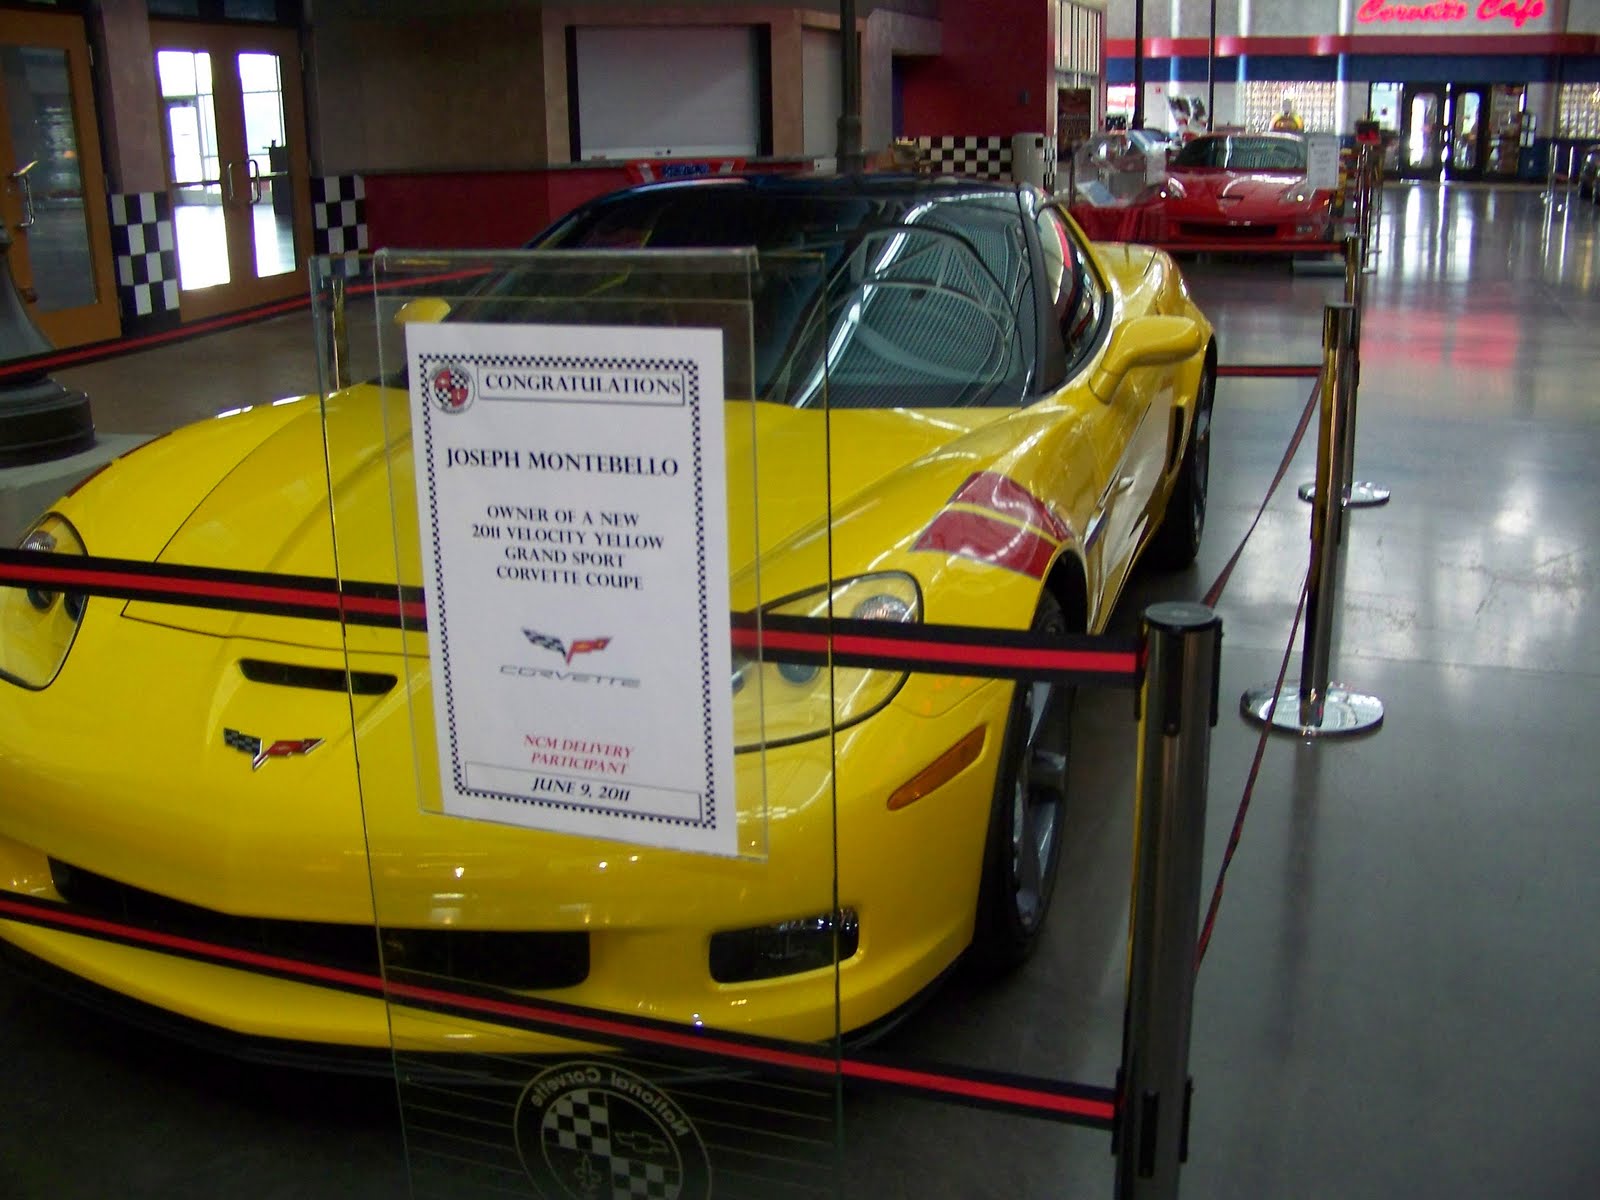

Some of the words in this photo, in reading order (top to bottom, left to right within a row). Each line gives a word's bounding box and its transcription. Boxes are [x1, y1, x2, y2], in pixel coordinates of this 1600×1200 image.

[485, 373, 682, 396] CONGRATULATIONS
[446, 447, 520, 469] JOSEPH
[528, 451, 679, 477] MONTEBELLO
[487, 505, 549, 522] OWNER
[555, 510, 576, 523] OF
[582, 511, 593, 525] A
[600, 512, 640, 527] NEW
[472, 524, 501, 539] 2011
[507, 527, 586, 545] VELOCITY
[594, 531, 664, 549] YELLOW
[505, 547, 567, 564] GRAND
[572, 552, 625, 568] SPORT
[497, 566, 578, 585] CORVETTE
[586, 572, 643, 591] COUPE
[500, 664, 641, 689] CORVETTE
[524, 734, 558, 750] NCM
[563, 738, 635, 759] DELIVERY
[531, 752, 628, 775] PARTICIPANT
[532, 776, 576, 796] JUNE
[580, 783, 593, 799] 9,
[599, 787, 631, 802] 2011
